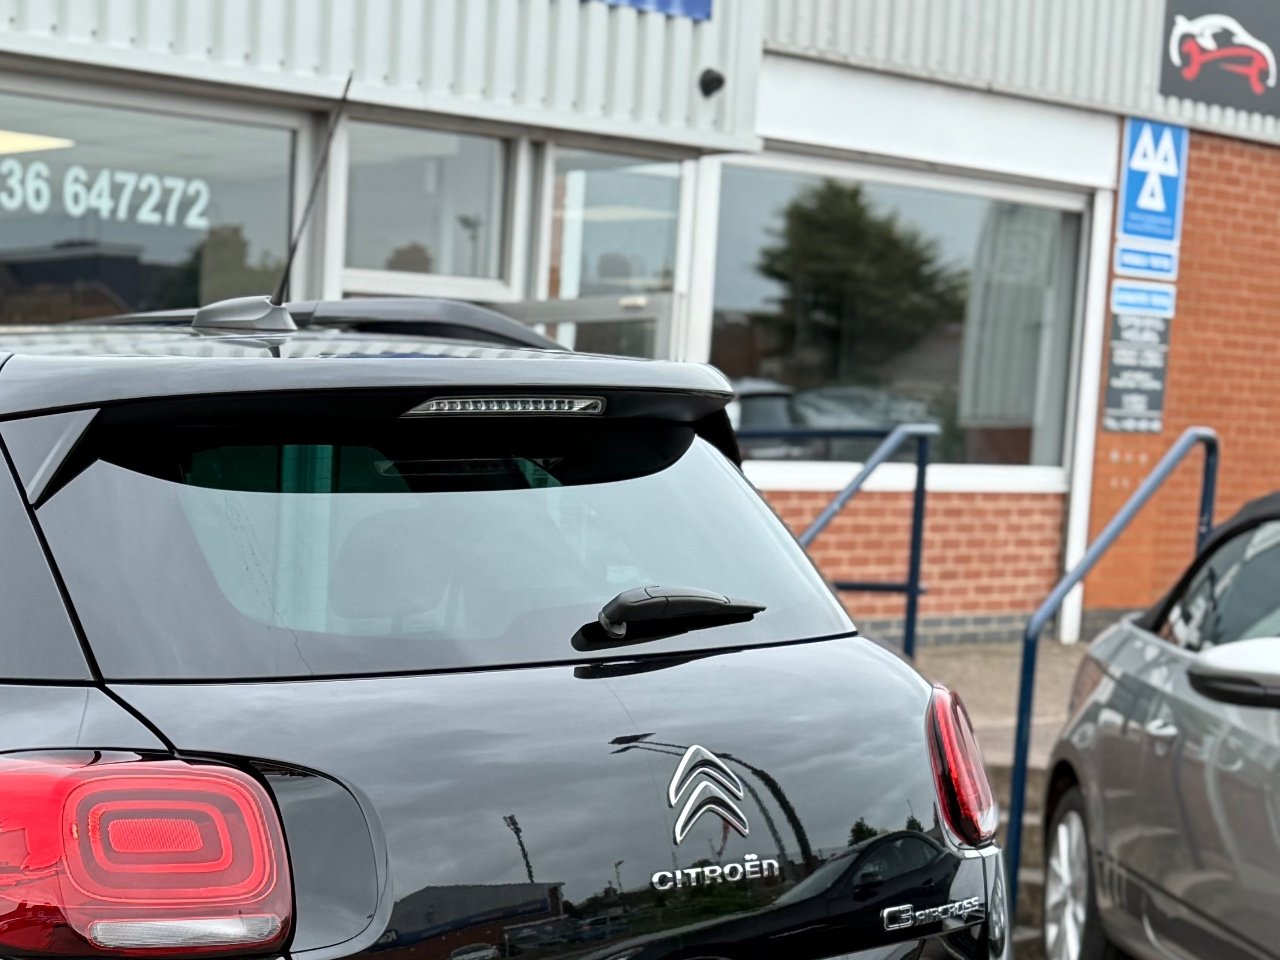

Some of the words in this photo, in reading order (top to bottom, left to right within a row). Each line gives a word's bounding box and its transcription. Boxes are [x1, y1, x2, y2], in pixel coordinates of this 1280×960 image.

[63, 166, 211, 229] 647272
[651, 853, 780, 890] CITROËN
[883, 904, 914, 931] C3
[915, 896, 979, 926] AIRCROSS
